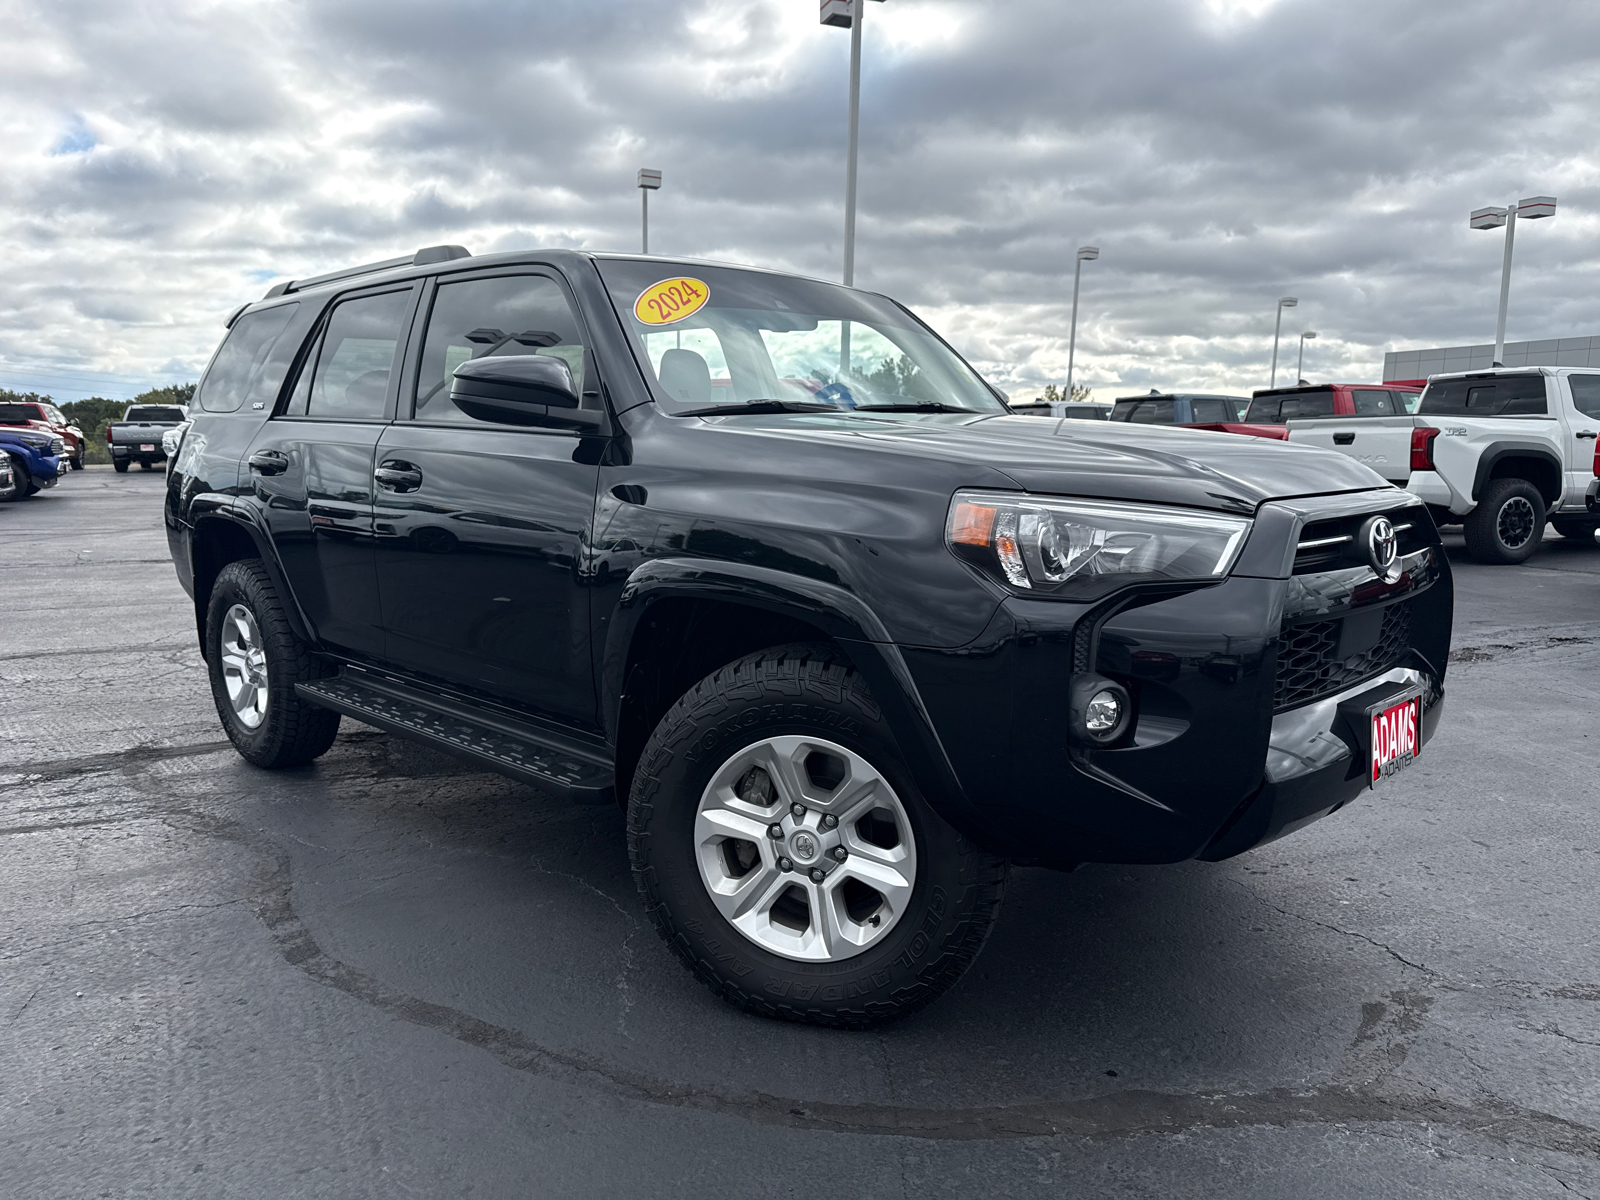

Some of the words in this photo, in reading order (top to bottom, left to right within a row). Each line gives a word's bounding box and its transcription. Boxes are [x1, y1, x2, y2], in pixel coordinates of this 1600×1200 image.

[647, 280, 702, 320] 2024
[683, 703, 864, 763] YOKOHAMA
[1373, 702, 1415, 771] ADAMS
[1383, 752, 1412, 780] ADAMS
[763, 885, 949, 1002] GEOLANDAR
